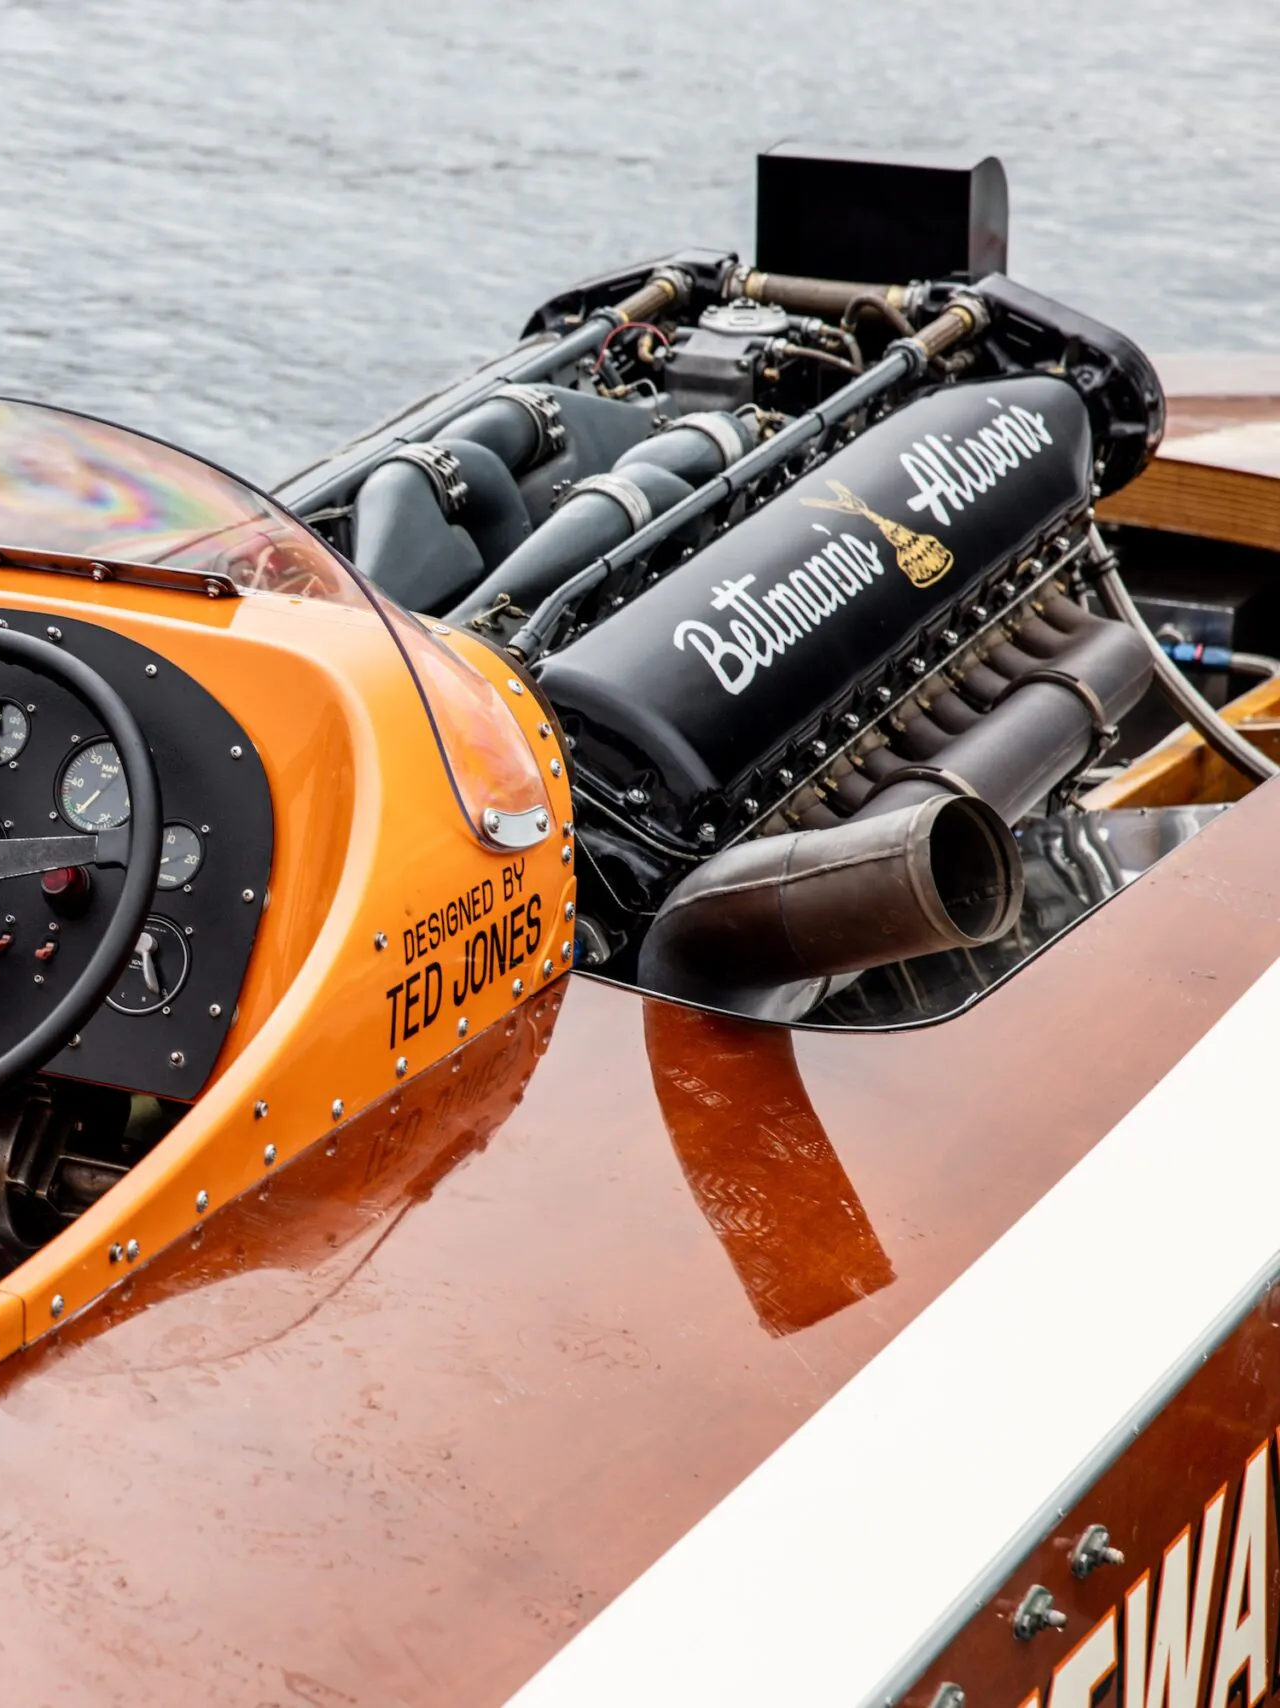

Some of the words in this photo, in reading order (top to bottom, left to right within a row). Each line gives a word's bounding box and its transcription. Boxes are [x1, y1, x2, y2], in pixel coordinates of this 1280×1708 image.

[90, 755, 102, 765] 50
[102, 765, 119, 773] MAN
[71, 778, 84, 788] 40
[167, 835, 176, 845] 10
[184, 854, 197, 864] 20
[403, 879, 493, 965] DESIGNED
[503, 857, 525, 901] BY
[386, 962, 442, 1050] TED
[453, 893, 542, 1006] JONES
